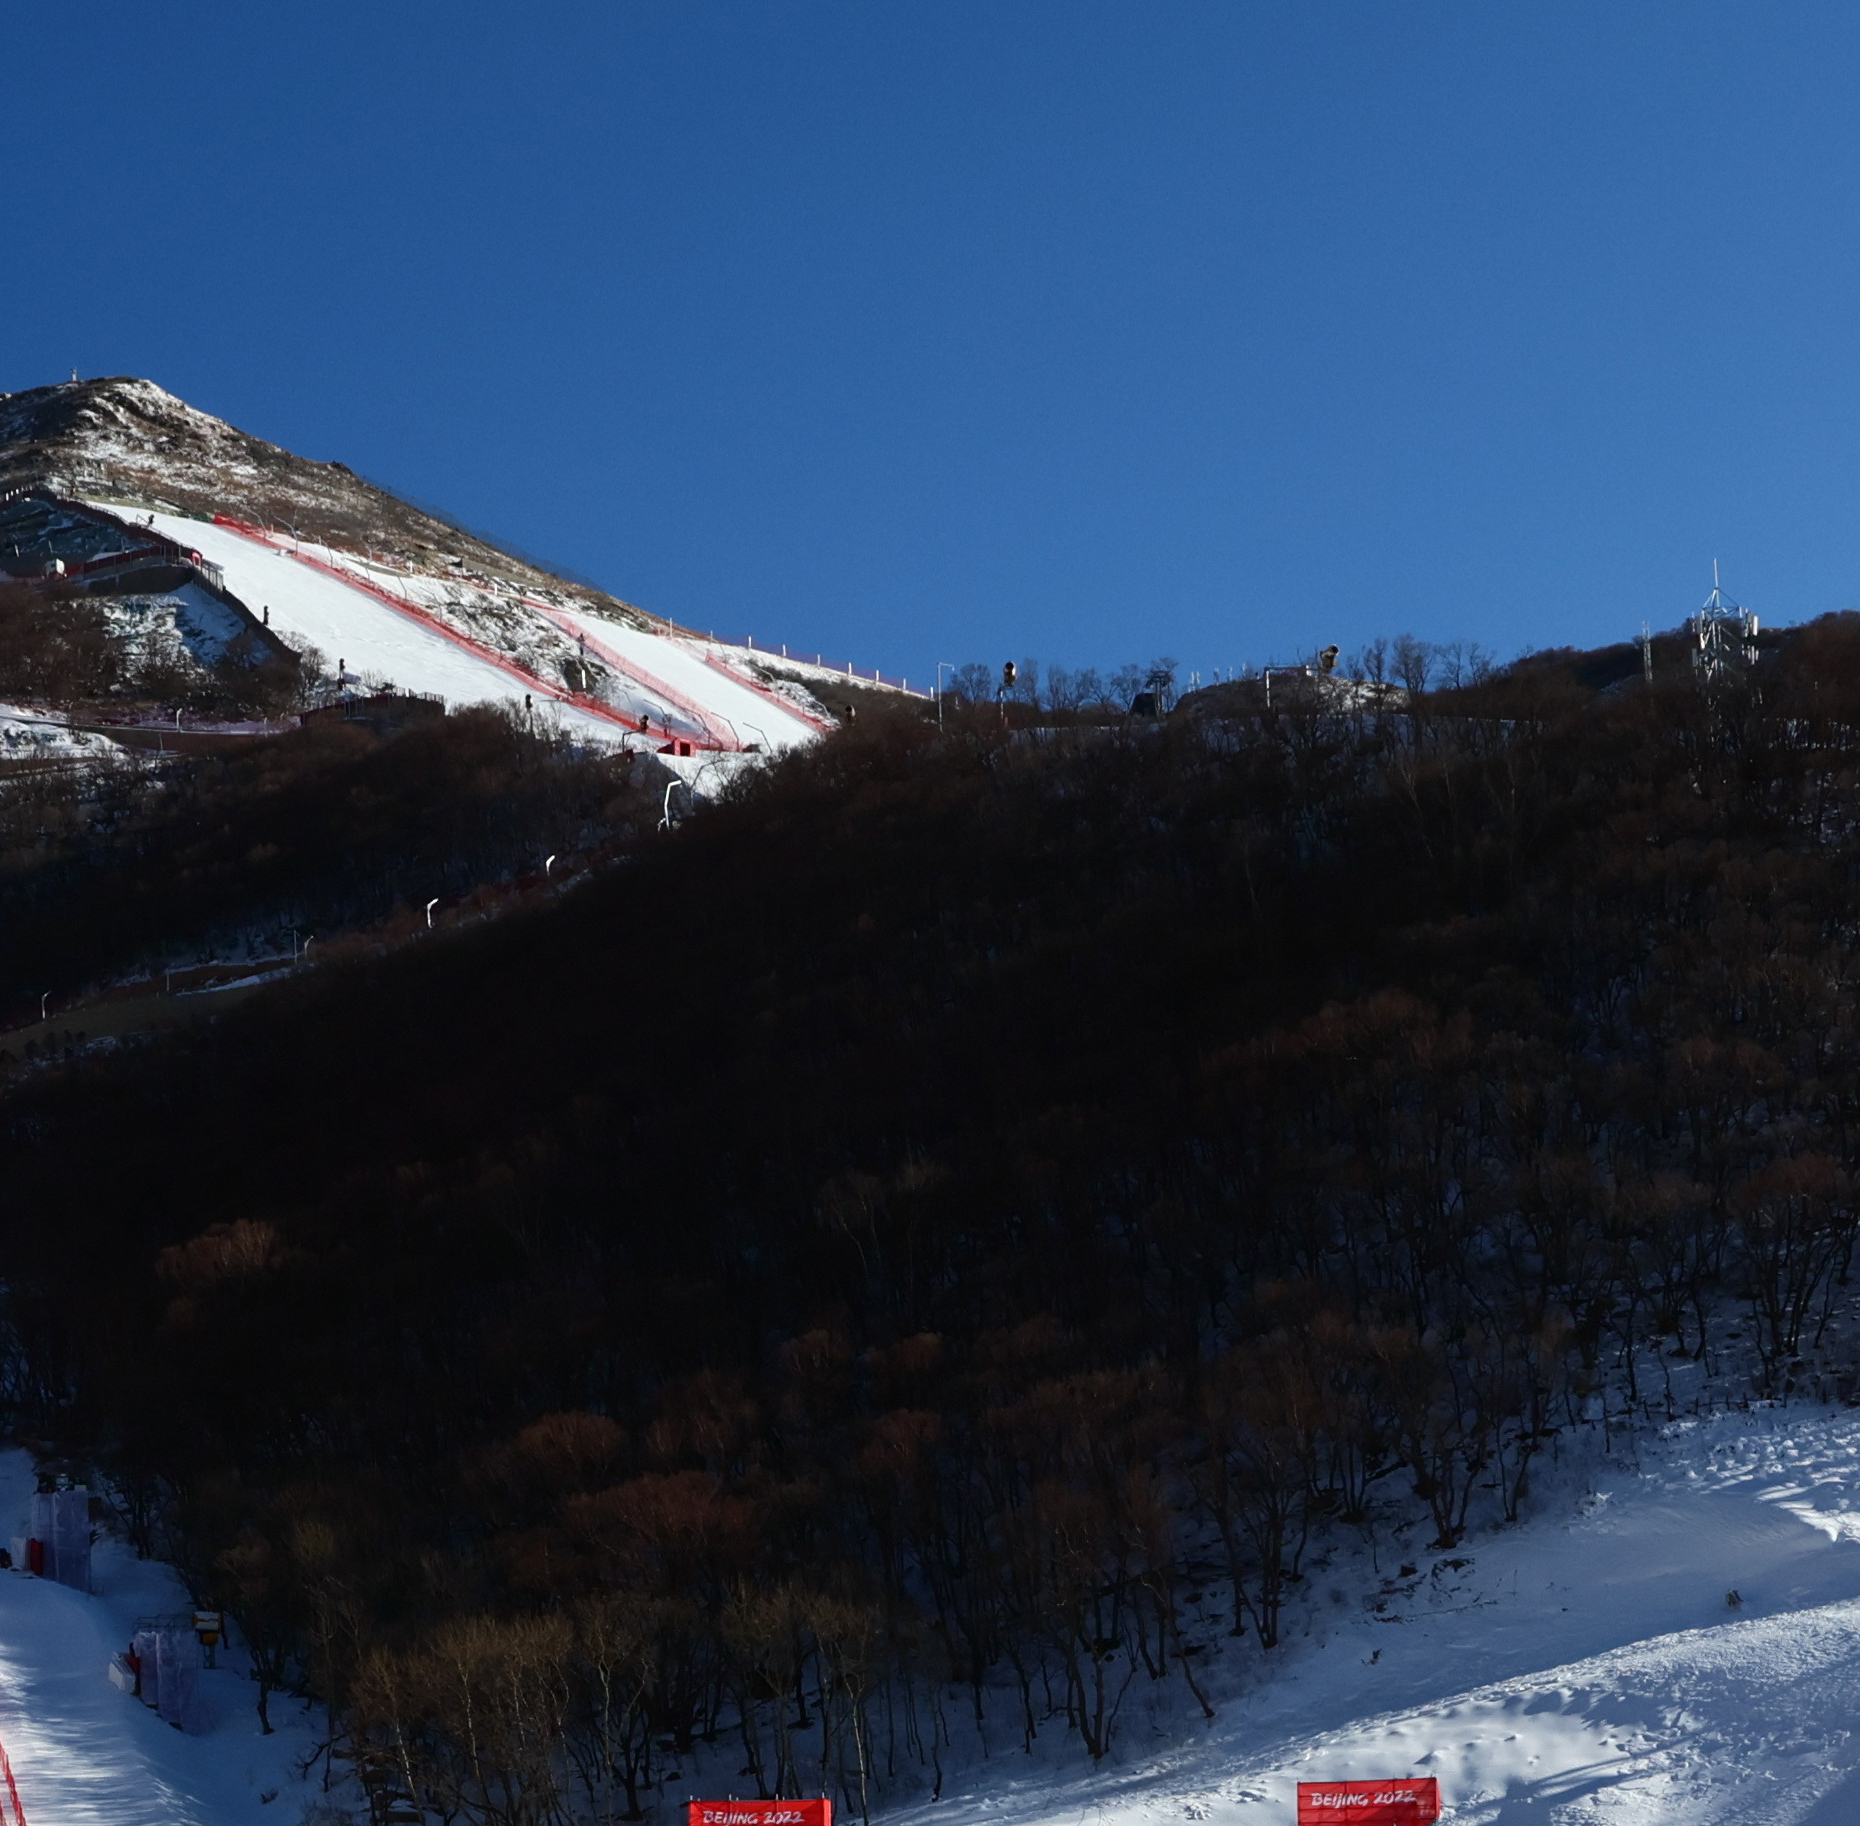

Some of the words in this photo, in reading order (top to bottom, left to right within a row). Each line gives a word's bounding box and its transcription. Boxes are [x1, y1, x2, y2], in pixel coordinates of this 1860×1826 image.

[1311, 1792, 1368, 1807] BEIJING
[1374, 1790, 1415, 1805] 2022
[702, 1811, 758, 1825] BEIJING
[763, 1811, 804, 1824] 2022
